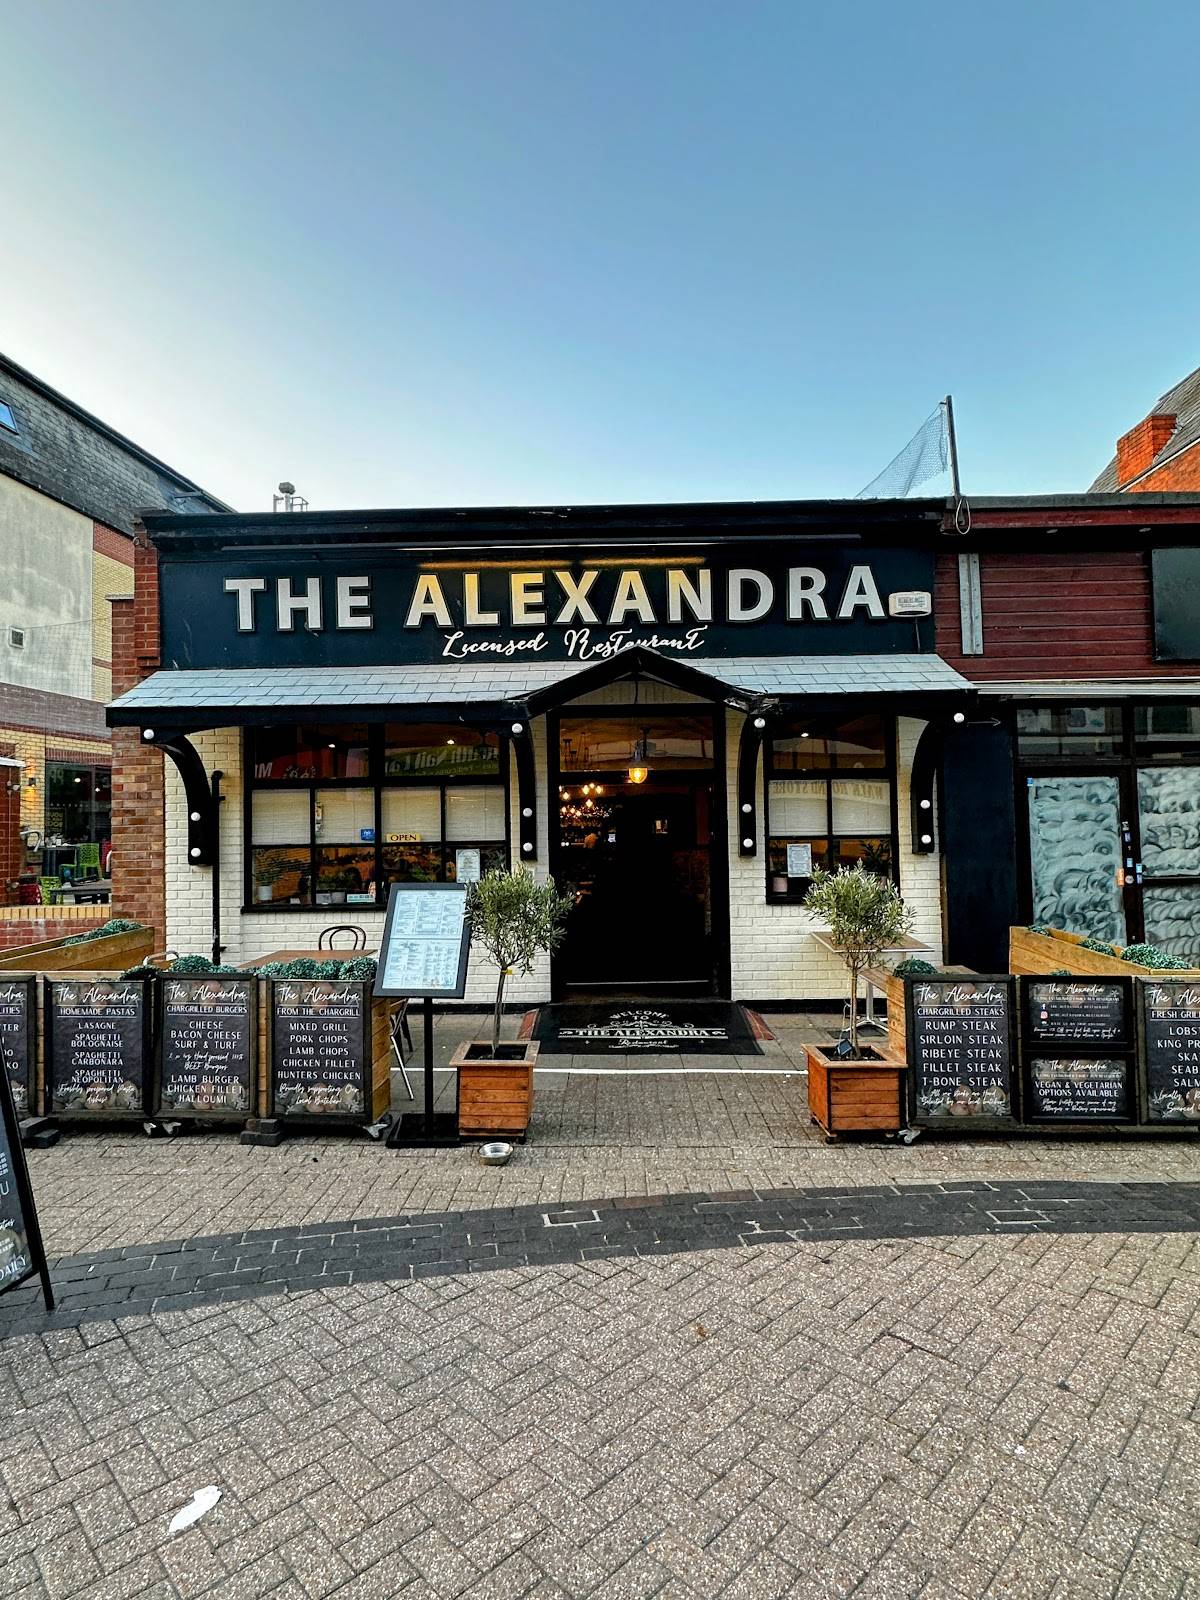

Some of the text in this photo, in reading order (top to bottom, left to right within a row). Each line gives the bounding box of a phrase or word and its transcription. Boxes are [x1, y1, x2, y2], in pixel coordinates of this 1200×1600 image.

[224, 565, 887, 631] THE ALEXANDRA
[442, 625, 708, 660] Licensed Restaurant
[168, 985, 247, 1001] The Alexandra
[1046, 983, 1104, 996] The Alexandra
[56, 987, 140, 1004] The Alexandra
[278, 986, 359, 1003] The Alexandra
[917, 986, 1002, 1003] The Alexandra
[1148, 989, 1171, 1004] The
[167, 1005, 247, 1013] CHARGRILLED BURGERS
[319, 1008, 360, 1016] CHARGRILL
[918, 1008, 1005, 1016] CHARGRILLED STEAKS
[609, 1010, 669, 1020] WELCOME
[189, 1021, 223, 1029] CHEESE
[289, 1023, 348, 1031] MIXED GRILL
[925, 1021, 997, 1030] RUMP STEAK
[171, 1031, 241, 1039] BACON CHEESE
[290, 1035, 348, 1044] PORK CHOPS
[920, 1035, 1003, 1044] SIRLOIN STEAK
[175, 1040, 197, 1049] SURF
[215, 1041, 237, 1049] TURF
[618, 1038, 668, 1046] Restaurant
[1157, 1040, 1181, 1048] KING
[289, 1047, 349, 1056] LAMB CHOPS
[922, 1049, 1002, 1058] RIBEYE STEAK
[1178, 1053, 1200, 1061] SKA
[283, 1059, 355, 1068] CHICKEN FILLET
[923, 1063, 1002, 1072] FILLET STEAK
[1049, 1060, 1106, 1071] The Alexandra
[171, 1075, 239, 1084] LAMB BURGER
[277, 1071, 360, 1080] HUNTERS CHICKEN
[922, 1077, 1004, 1087] T-BONE STEAK
[1074, 1081, 1122, 1089] VEGETARIAN
[167, 1084, 242, 1093] CHICKEN FILLET
[1076, 1089, 1118, 1097] AVAILABLE
[179, 1095, 226, 1103] HALLOUMI
